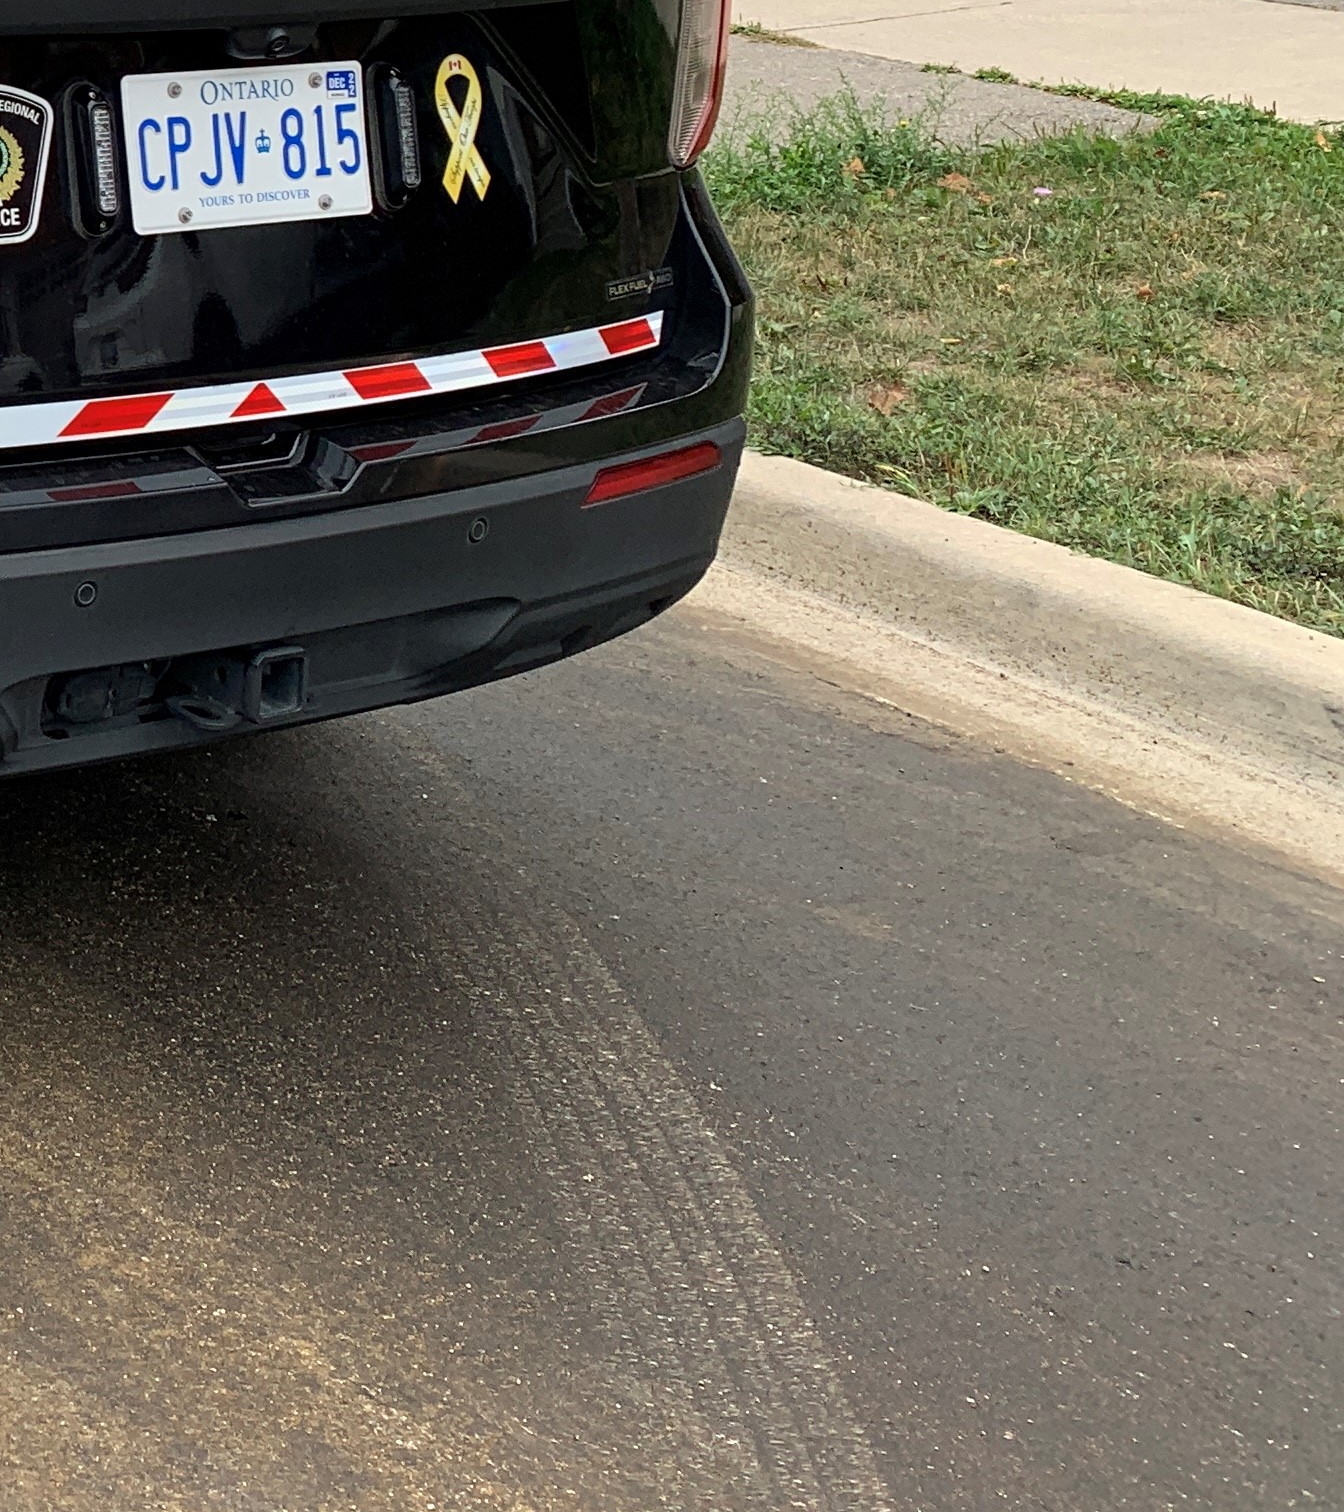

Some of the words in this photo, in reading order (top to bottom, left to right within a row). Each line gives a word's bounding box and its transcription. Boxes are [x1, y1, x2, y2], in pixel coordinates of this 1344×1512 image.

[328, 77, 346, 89] DEC
[199, 193, 234, 208] YOURS
[238, 193, 253, 204] TO
[256, 189, 310, 202] DISCOVER
